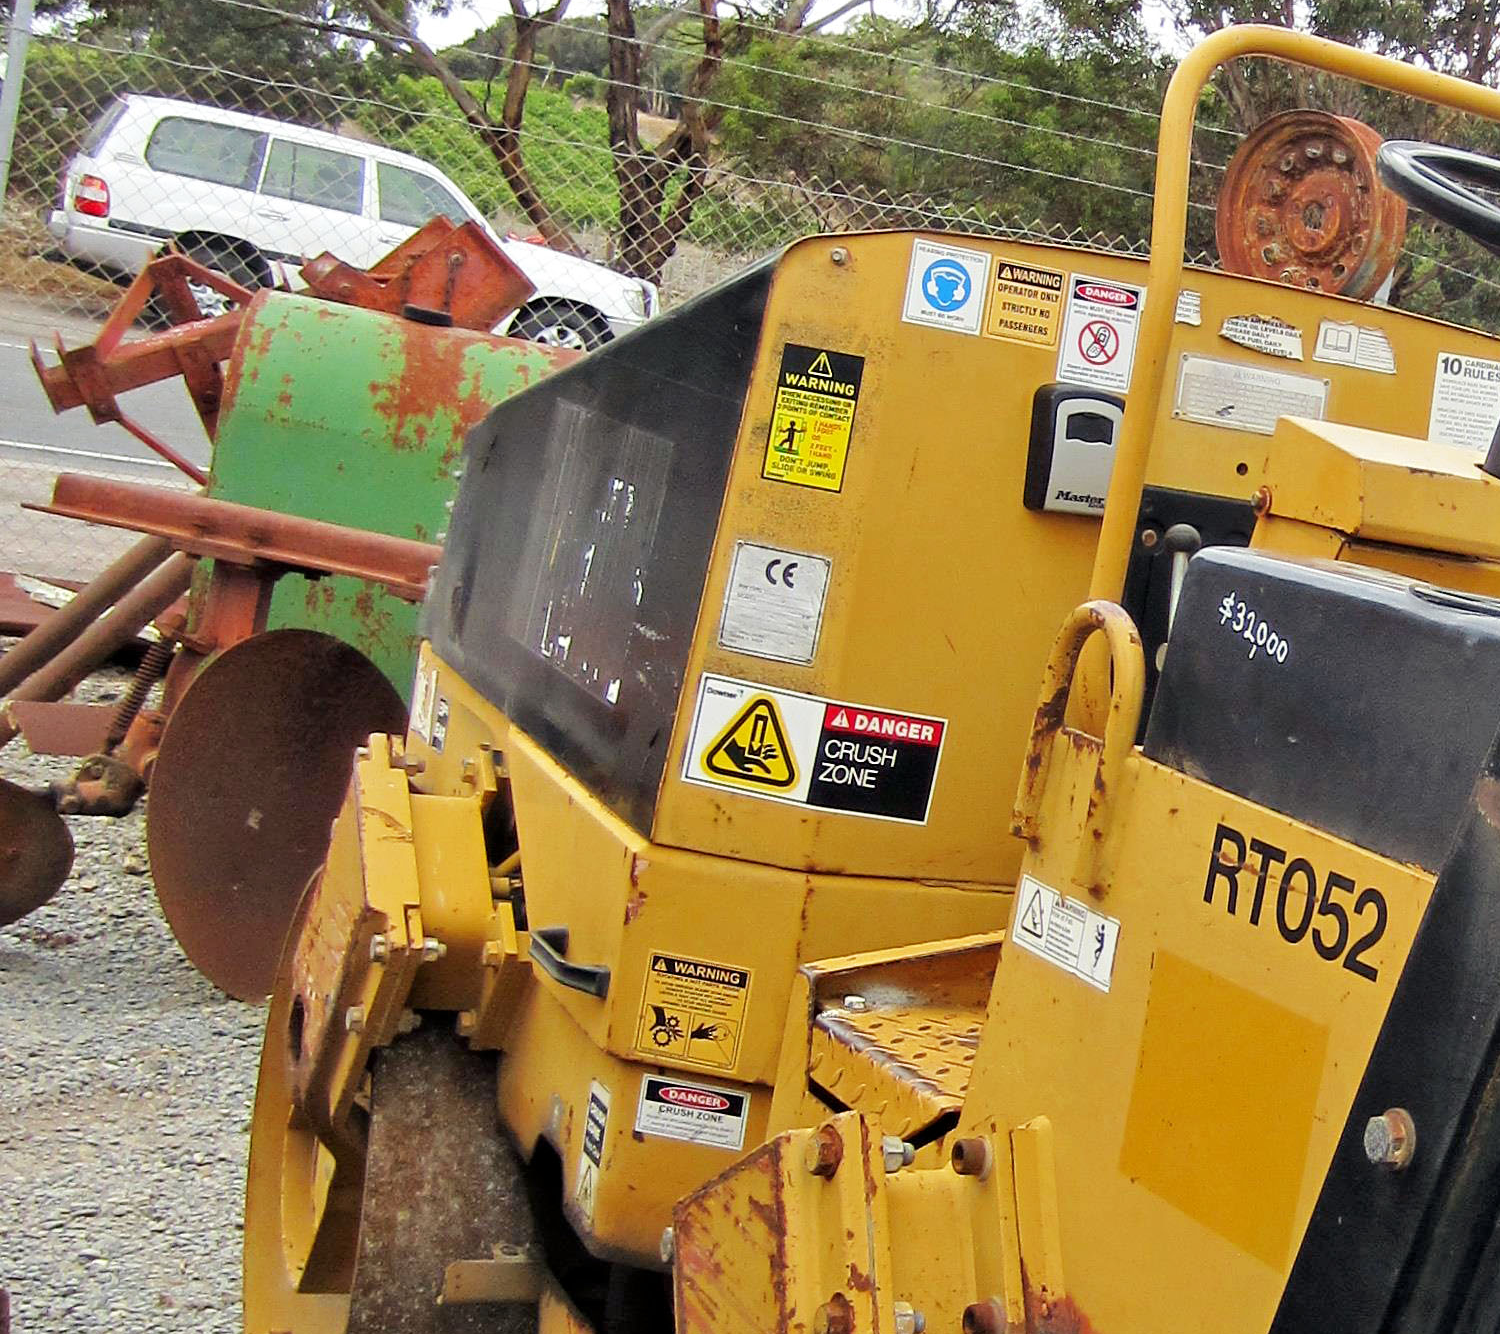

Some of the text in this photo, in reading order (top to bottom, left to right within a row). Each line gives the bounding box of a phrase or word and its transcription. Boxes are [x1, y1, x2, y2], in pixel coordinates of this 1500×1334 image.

[1013, 267, 1061, 288] WARNING
[998, 282, 1060, 303] OPERATOR ONLY
[1085, 287, 1128, 303] DANGER
[1001, 301, 1051, 319] STRICTLY NO
[999, 318, 1048, 336] PASSENGERS
[1441, 356, 1463, 376] 10
[785, 372, 856, 397] WARNING
[781, 389, 802, 399] WHEN
[803, 394, 842, 406] ACCESSING
[782, 404, 807, 415] POINTS
[808, 409, 818, 417] OF
[819, 411, 851, 423] CONTACT
[809, 402, 849, 416] REMEMBER
[780, 454, 804, 465] DON'T
[1056, 490, 1105, 504] Master
[765, 559, 799, 589] CE
[1219, 592, 1288, 663] $32,000
[855, 714, 935, 742] DANGER
[824, 739, 898, 767] CRUSH
[818, 762, 879, 788] ZONE
[674, 961, 740, 984] WARNING
[667, 1089, 722, 1108] DANGER
[659, 1104, 724, 1124] CRUSH ZONE
